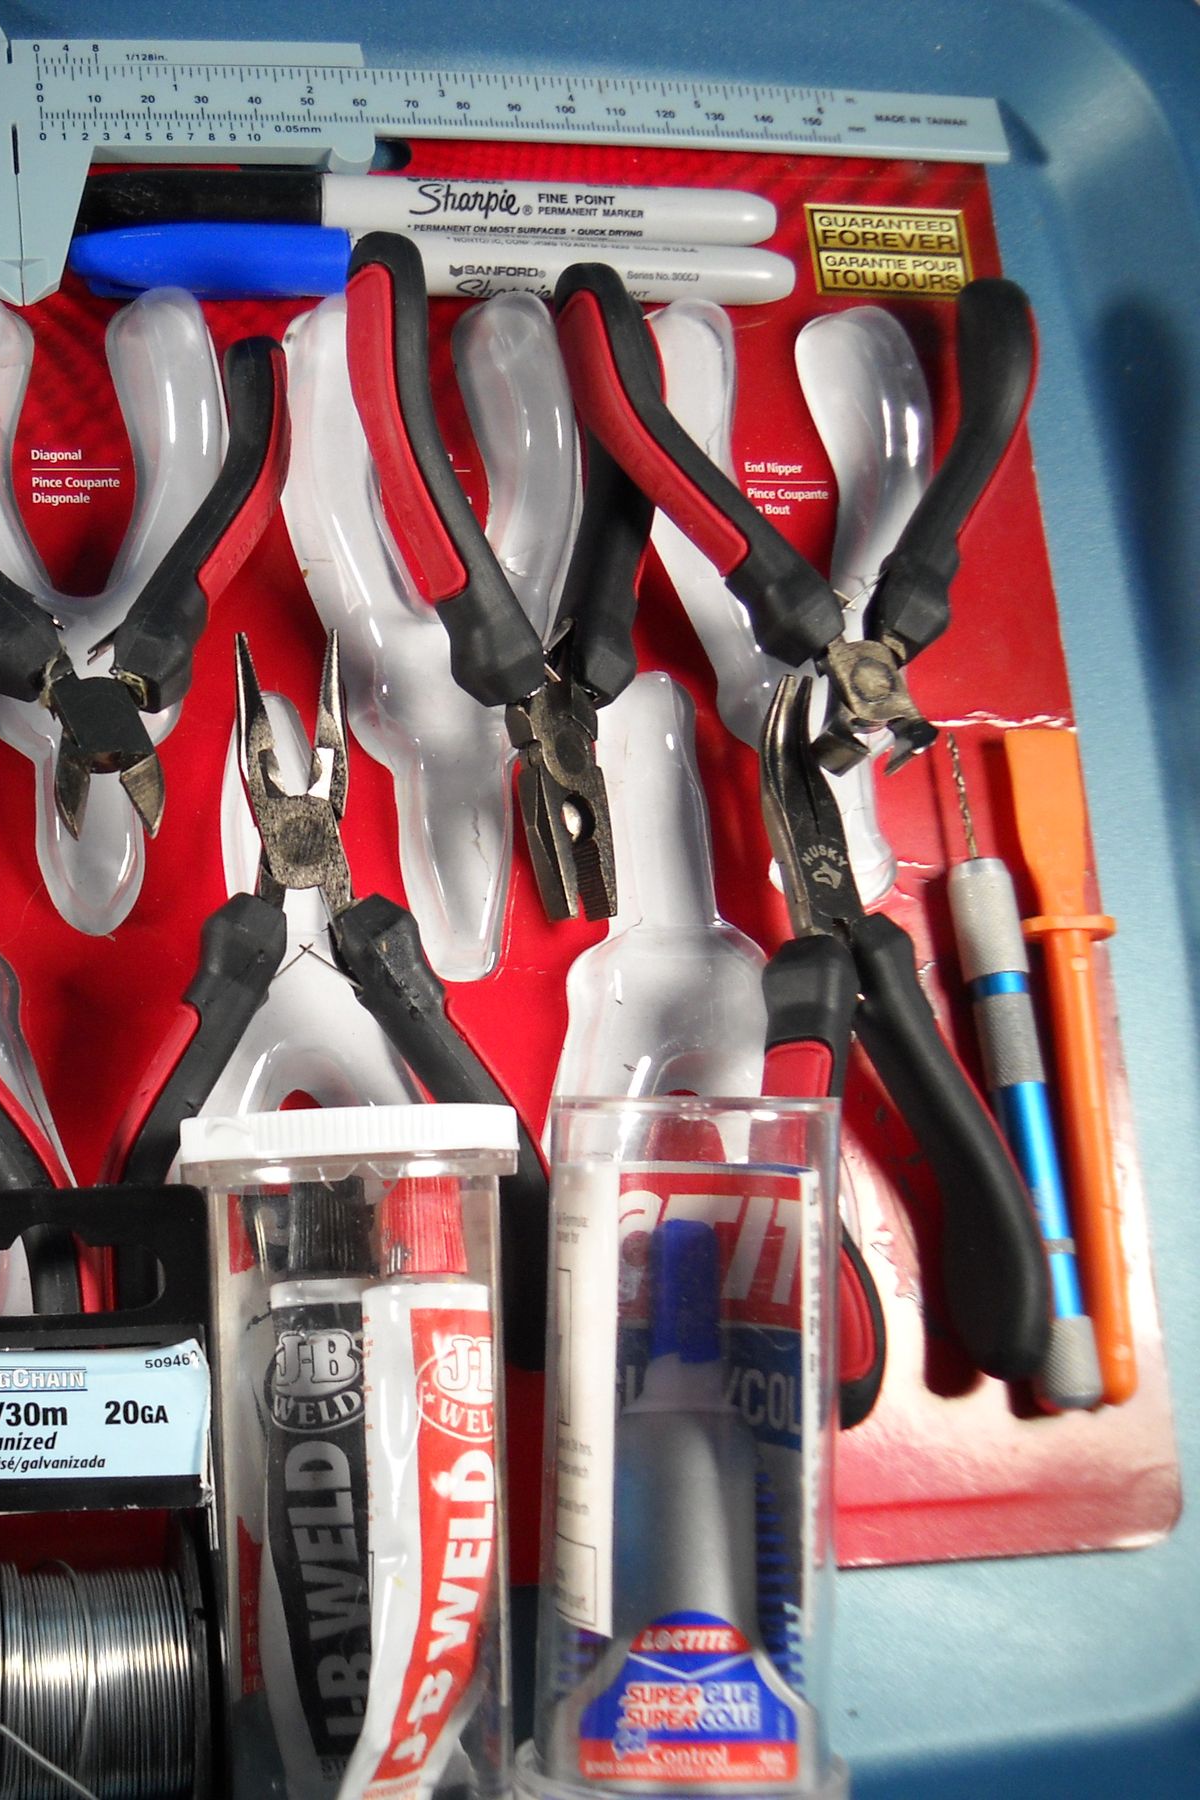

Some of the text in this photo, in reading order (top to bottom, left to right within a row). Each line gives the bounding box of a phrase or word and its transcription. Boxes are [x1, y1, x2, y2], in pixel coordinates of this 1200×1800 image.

[141, 95, 208, 104] 20 30
[274, 124, 322, 134] 0.05mm
[410, 184, 520, 219] Sharpie
[538, 193, 616, 206] FINE POINT
[538, 206, 644, 218] PERMANENT MARKER
[473, 225, 487, 233] ON
[489, 226, 516, 234] MOST
[517, 226, 566, 236] SURFACES
[818, 215, 952, 232] GUARANTEED
[822, 230, 956, 250] FOREVER
[465, 265, 538, 277] SANFORD
[825, 256, 958, 272] GARANTIE POUR
[827, 269, 961, 290] TOUJOURS
[31, 449, 82, 463] Diagonal
[745, 462, 802, 476] End Nipper
[32, 477, 120, 490] Pince Coupante
[32, 492, 90, 506] Diagonale
[747, 488, 828, 502] Pince Coupante
[765, 504, 790, 514] Bout
[275, 1328, 361, 1386] J-B
[104, 1400, 169, 1425] 20GA
[284, 1440, 372, 1642] WELD
[392, 1668, 454, 1764] J-B
[426, 1449, 495, 1664] WELD
[641, 1630, 733, 1650] LOCTITE
